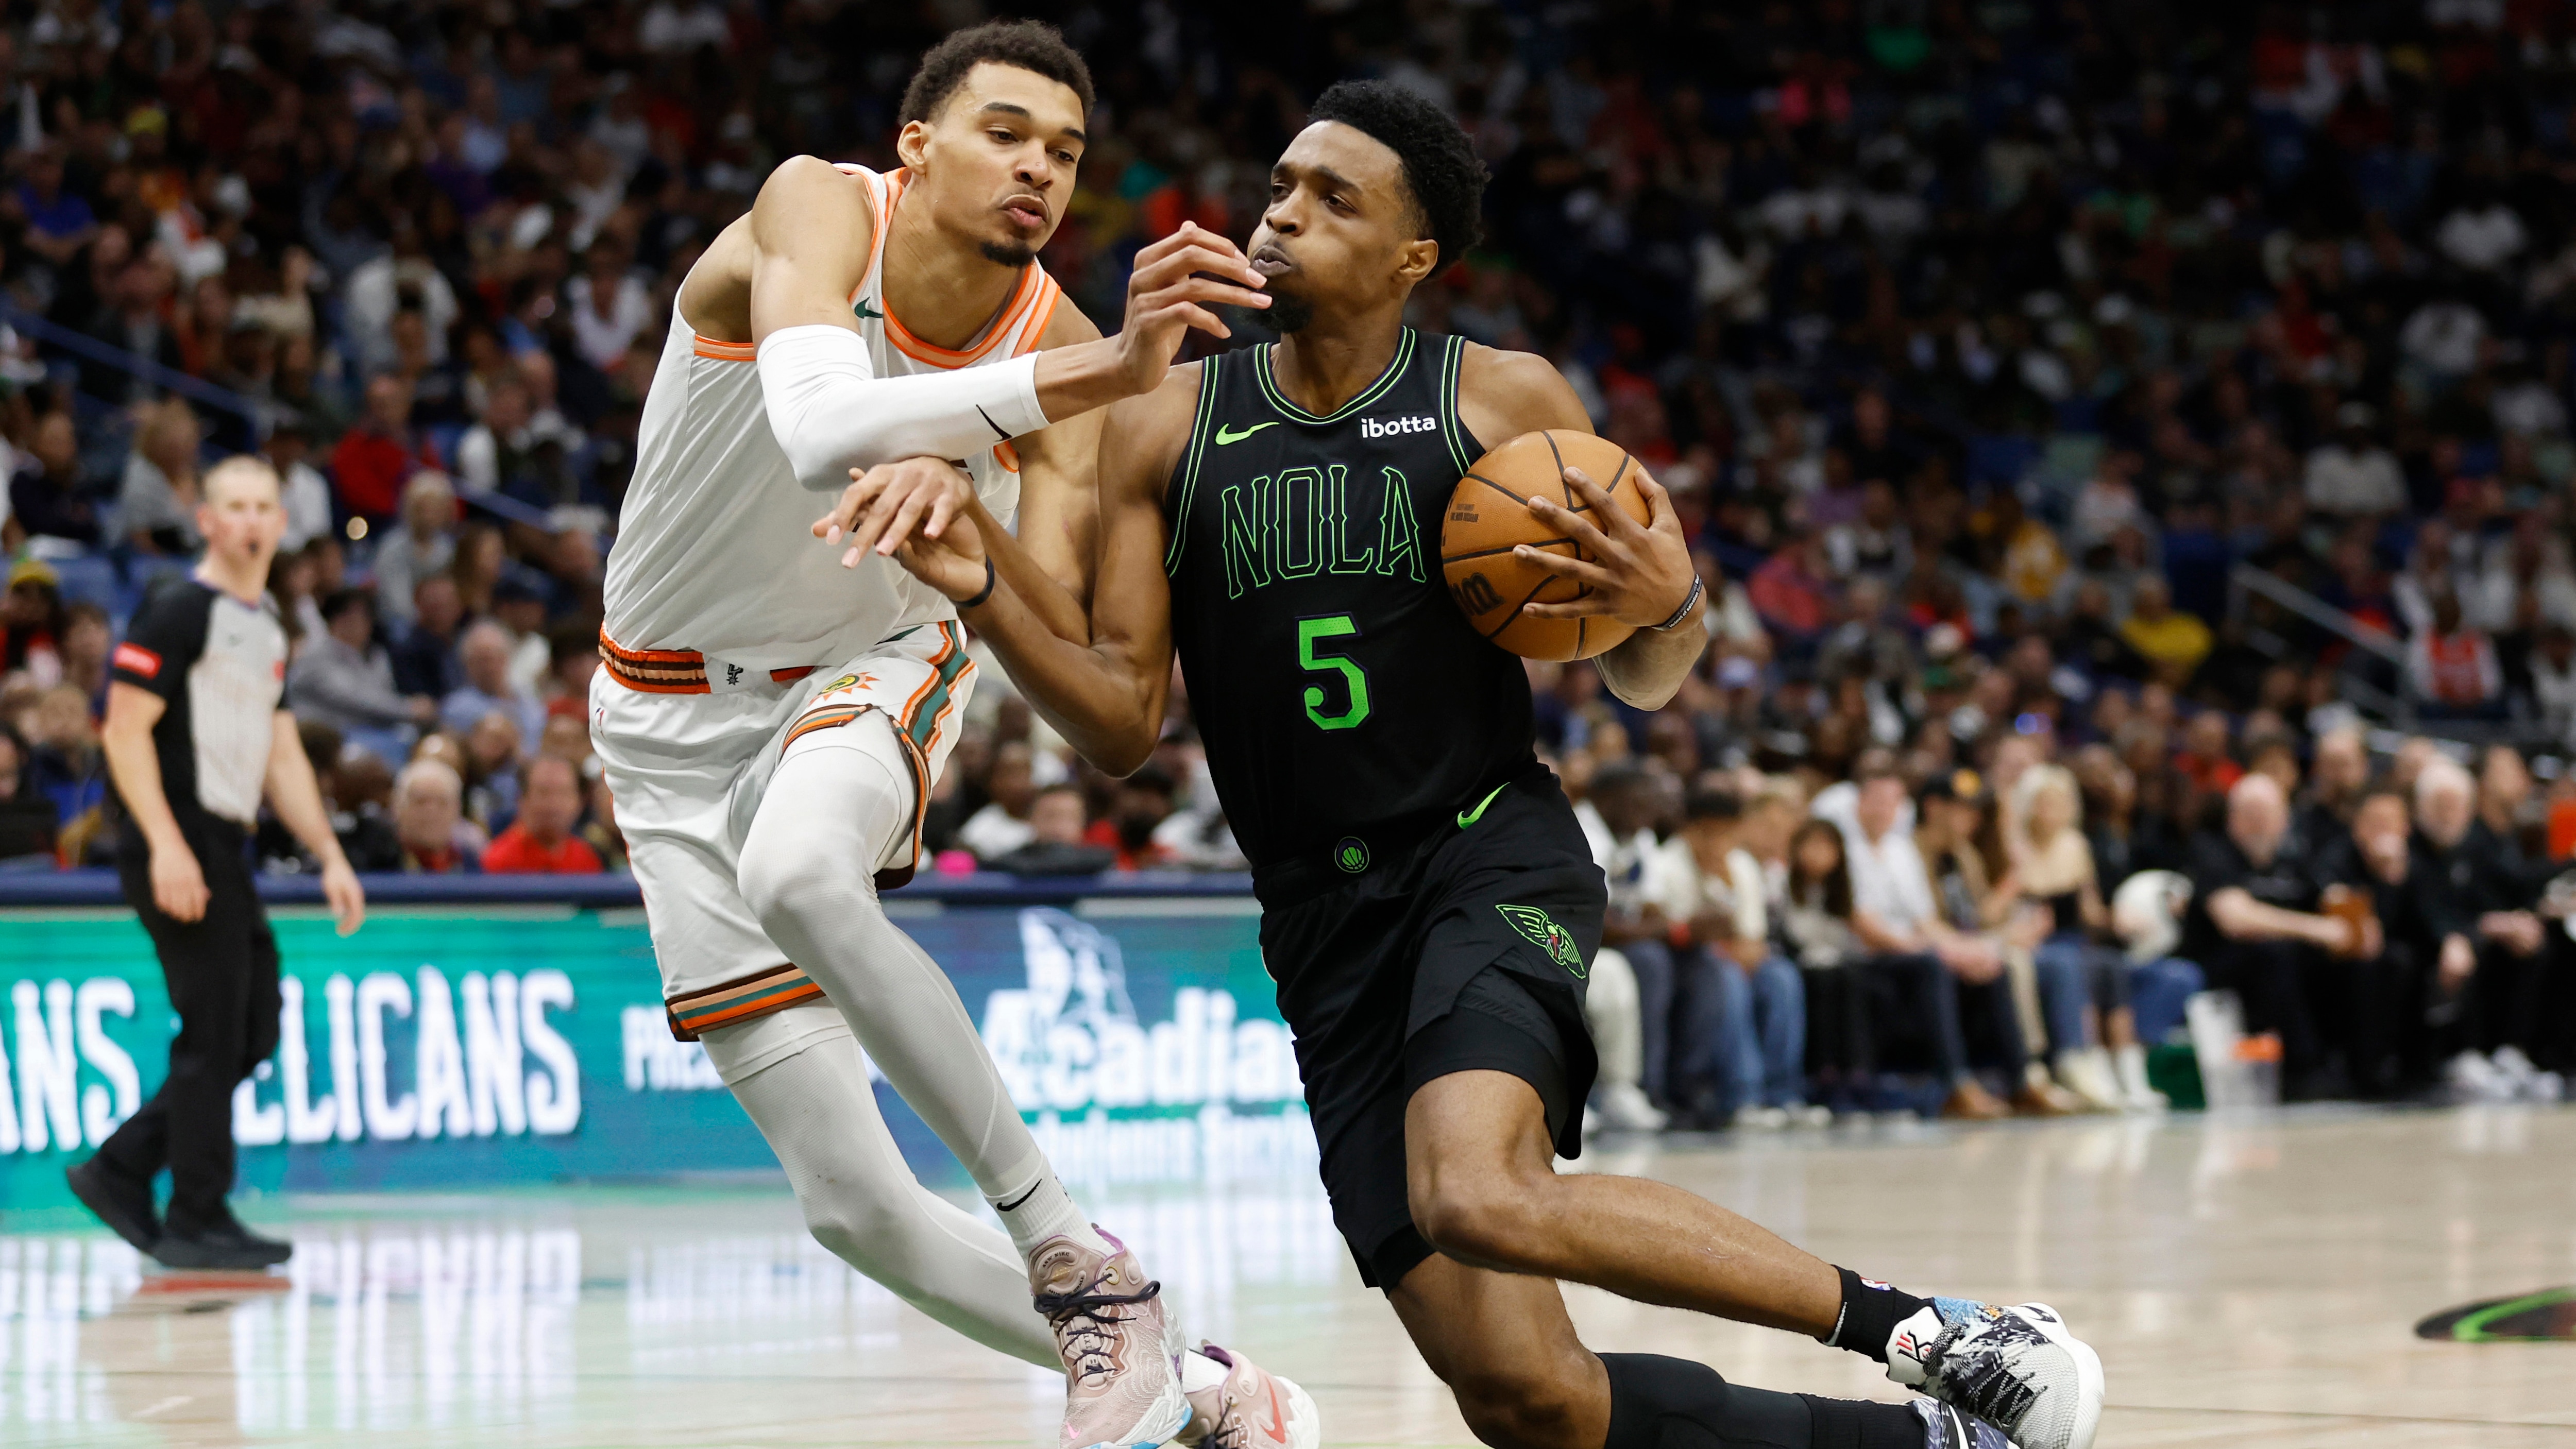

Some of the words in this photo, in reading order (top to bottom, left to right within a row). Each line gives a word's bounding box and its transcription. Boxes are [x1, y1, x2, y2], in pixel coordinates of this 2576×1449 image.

[1361, 416, 1436, 438] ibotta
[1221, 463, 1427, 600] NOLA
[1669, 615, 1683, 628] Helmet
[1686, 591, 1699, 611] salvation
[1297, 613, 1371, 730] 5
[0, 976, 142, 1154] NS
[233, 964, 582, 1145] LICANS
[983, 987, 1306, 1107] Acadia
